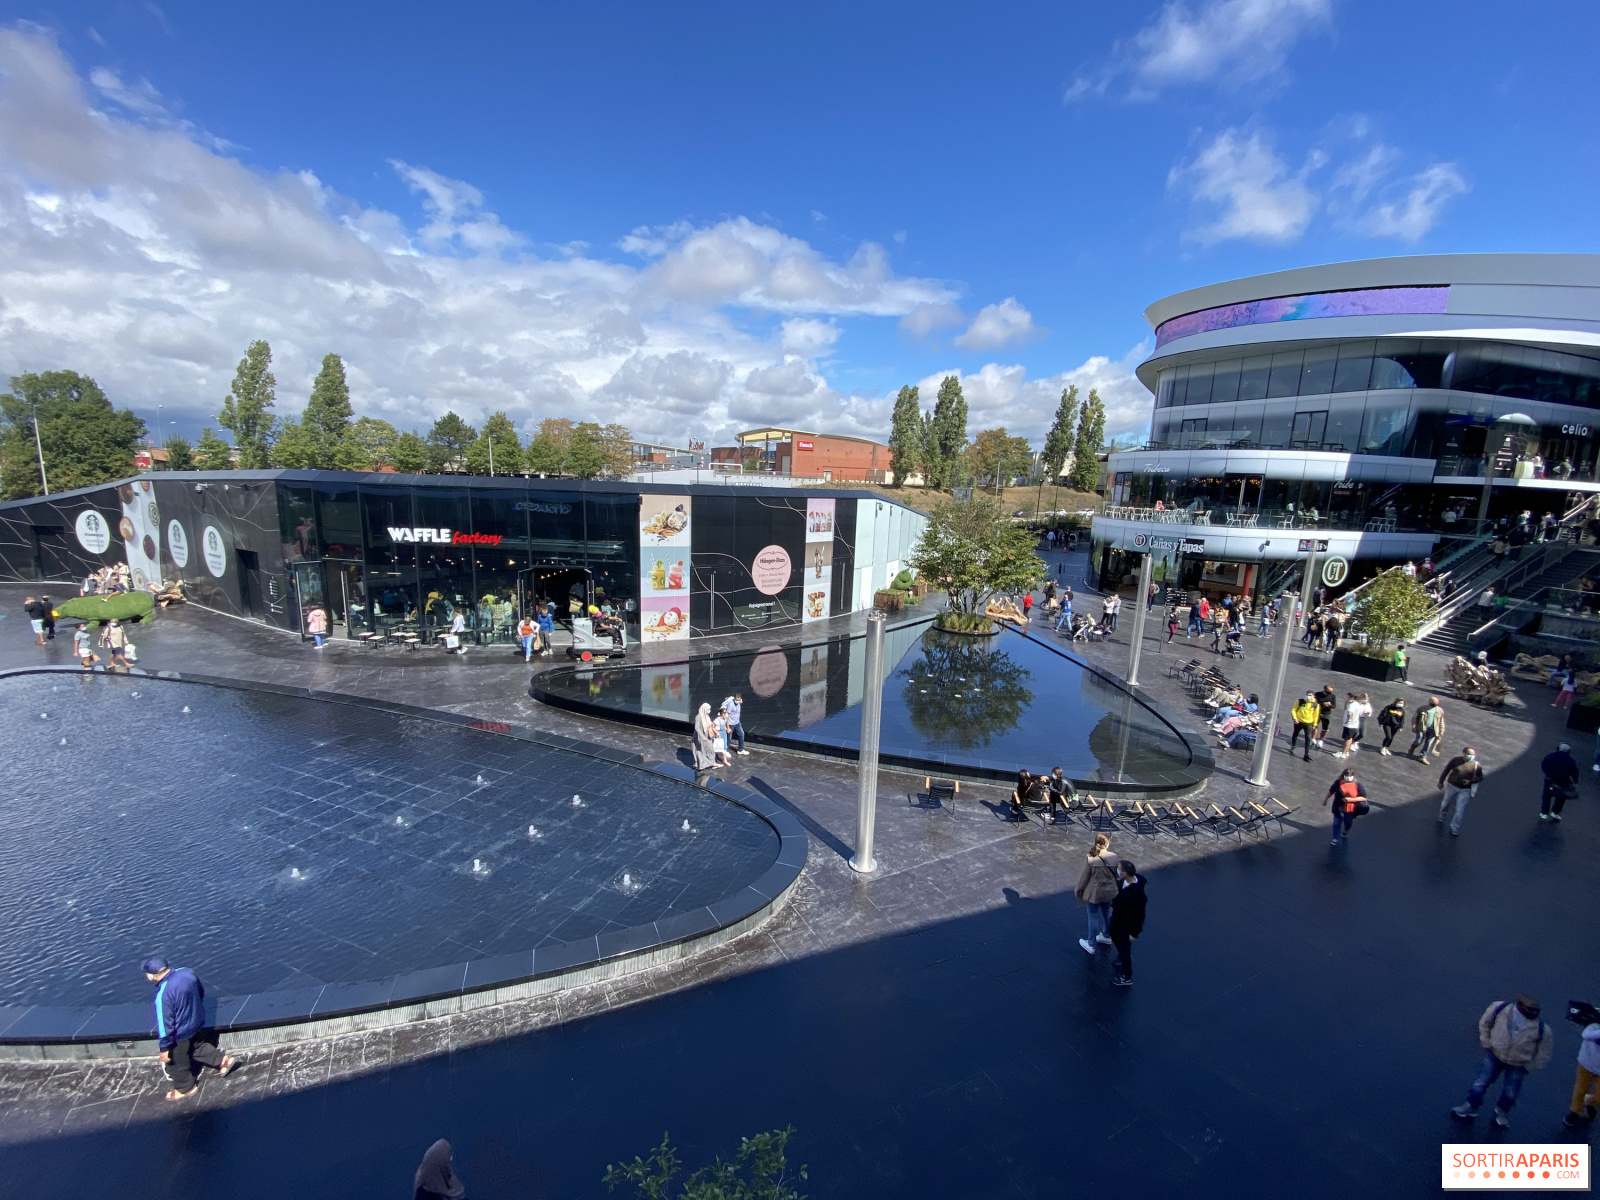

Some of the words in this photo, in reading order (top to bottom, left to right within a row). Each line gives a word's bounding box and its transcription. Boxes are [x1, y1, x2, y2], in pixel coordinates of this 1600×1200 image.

[1143, 463, 1171, 473] Tribeca
[387, 526, 451, 543] WAFFLE
[452, 531, 504, 546] factory
[1149, 535, 1173, 550] Cañas
[1173, 542, 1180, 552] y
[1178, 538, 1204, 553] Tapas
